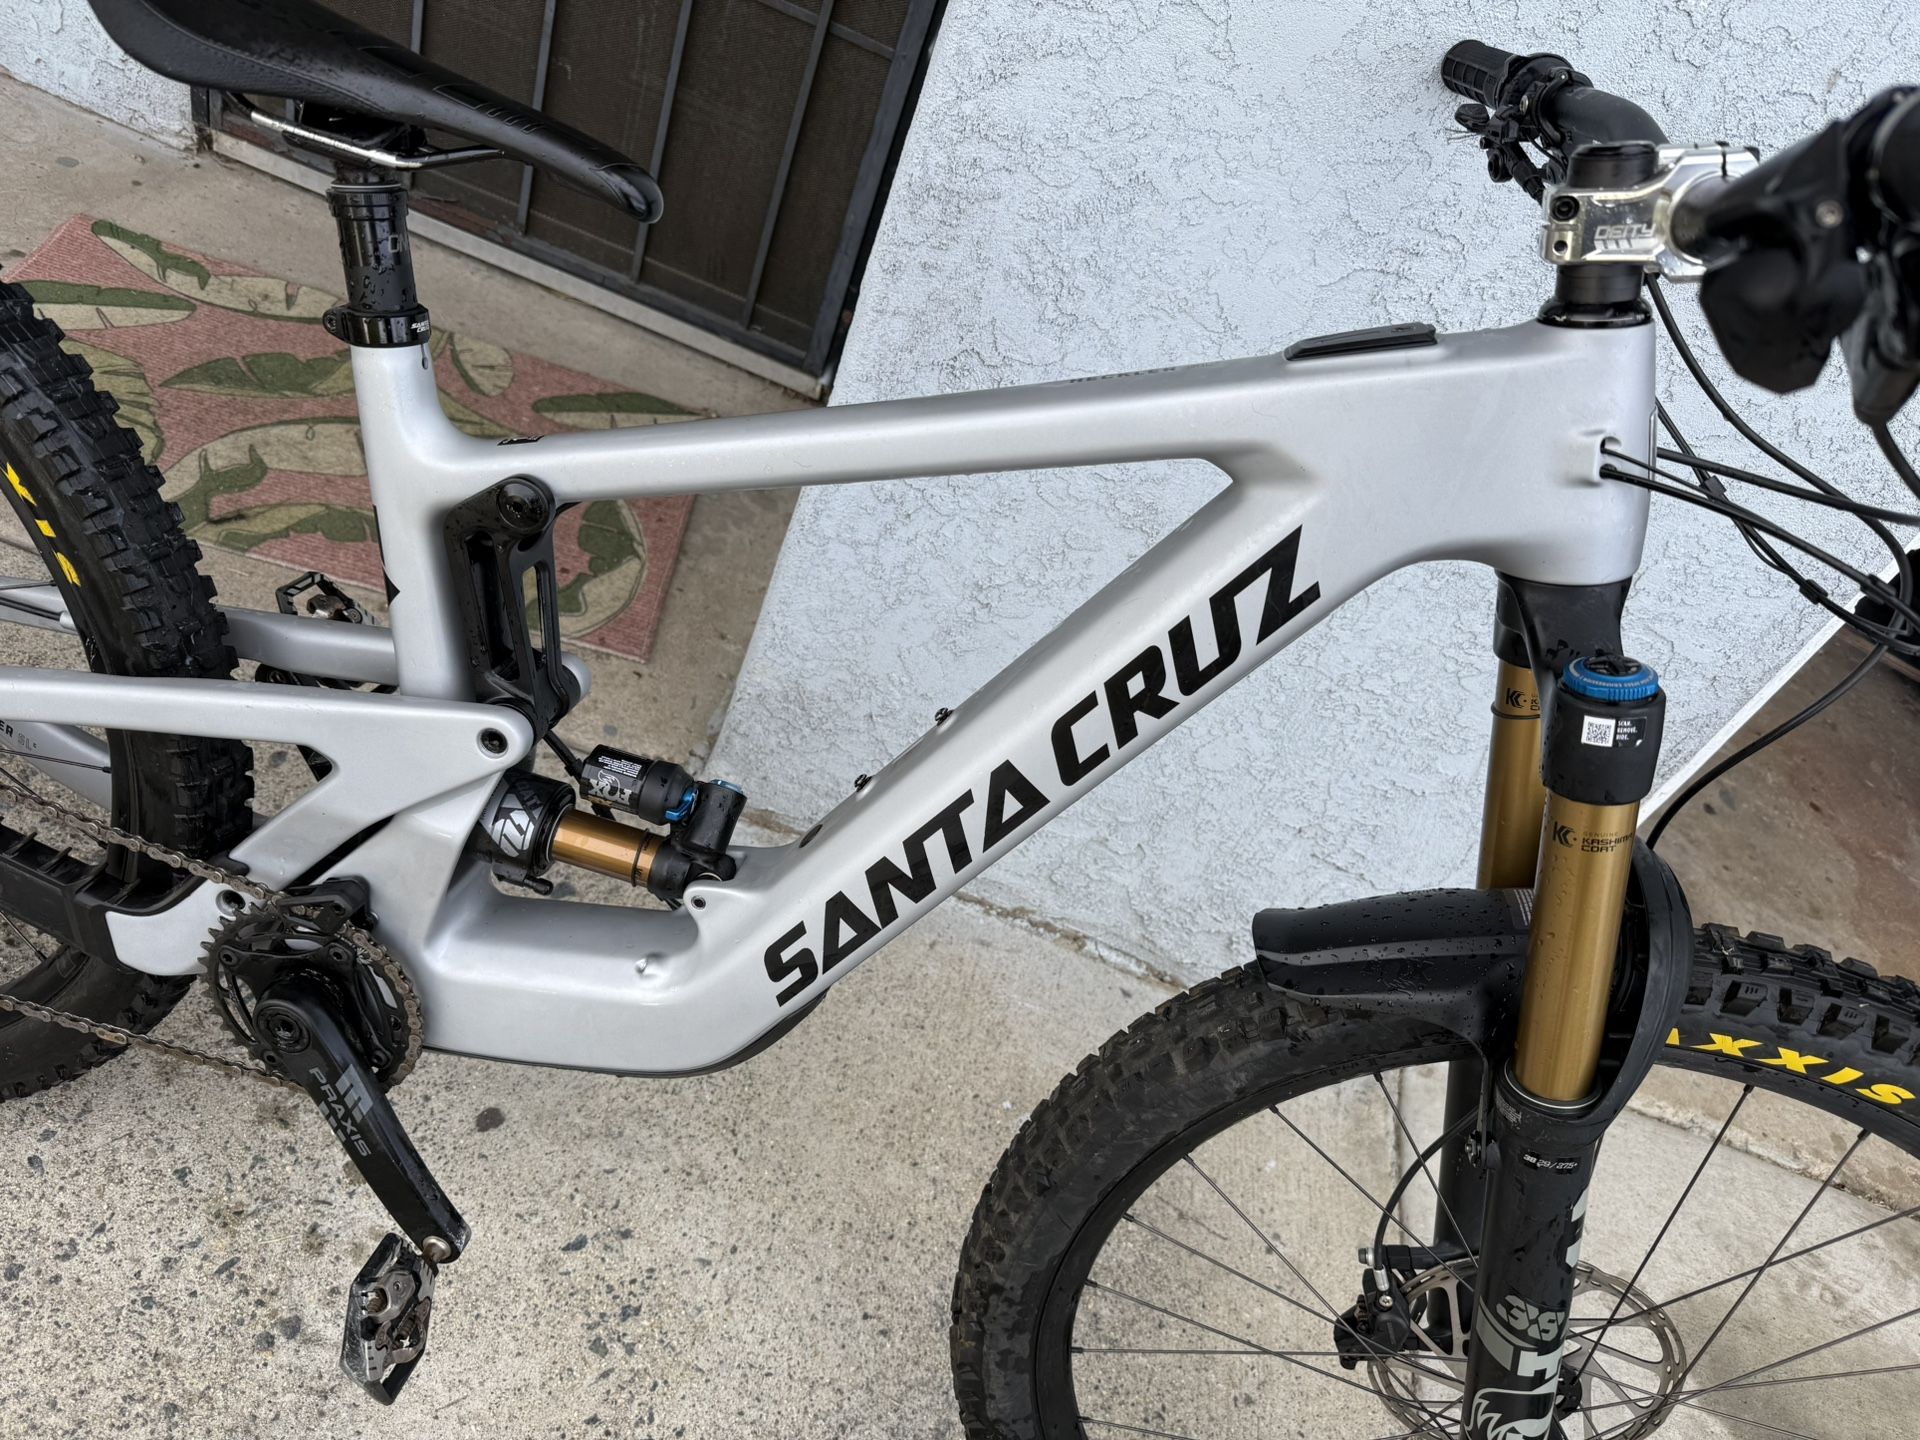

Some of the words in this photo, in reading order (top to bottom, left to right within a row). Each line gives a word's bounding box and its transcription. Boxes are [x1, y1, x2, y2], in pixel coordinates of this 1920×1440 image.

[1594, 223, 1657, 240] DEITY
[587, 769, 634, 806] FOX
[763, 758, 1051, 1007] SANTA
[1050, 523, 1321, 787] CRUZ
[1581, 845, 1617, 854] COAT
[1665, 1027, 1917, 1105] XXIS
[308, 1066, 372, 1158] PRAXIS
[1495, 1294, 1567, 1342] 38
